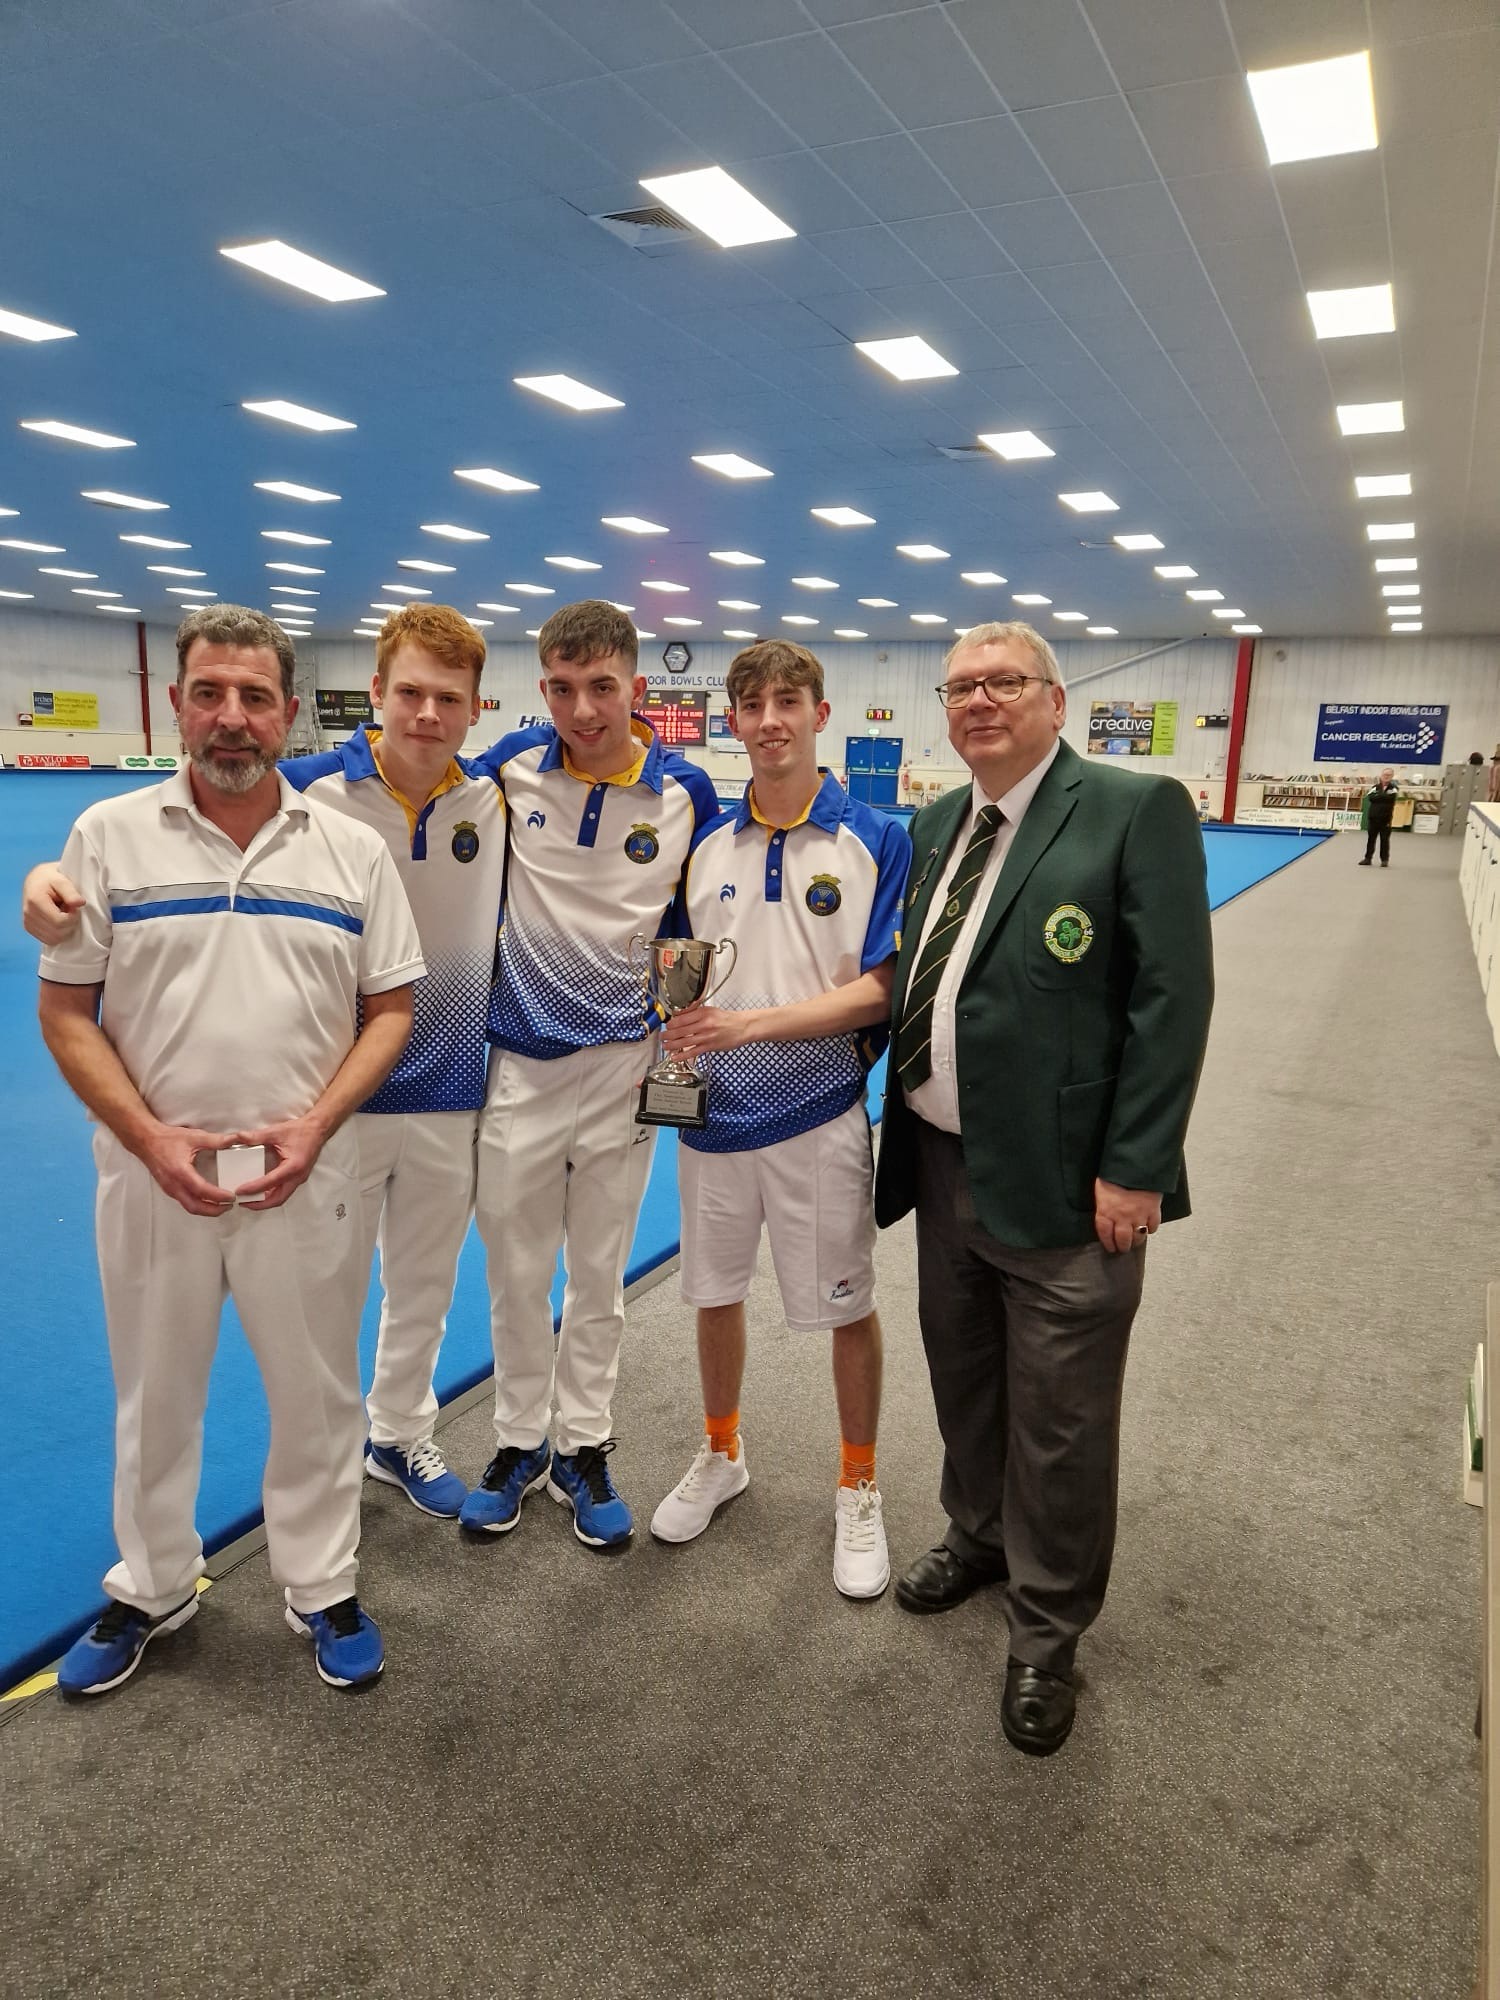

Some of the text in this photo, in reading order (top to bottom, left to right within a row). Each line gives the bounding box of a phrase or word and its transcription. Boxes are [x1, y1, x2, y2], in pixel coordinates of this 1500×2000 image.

[647, 675, 725, 686] OOR BOWLS CLU
[1325, 705, 1442, 716] BELFAST INDOOR BOWLS CLUB
[1090, 717, 1153, 731] creative
[1321, 733, 1417, 742] CANCER RESEARCH
[1083, 927, 1094, 936] 66
